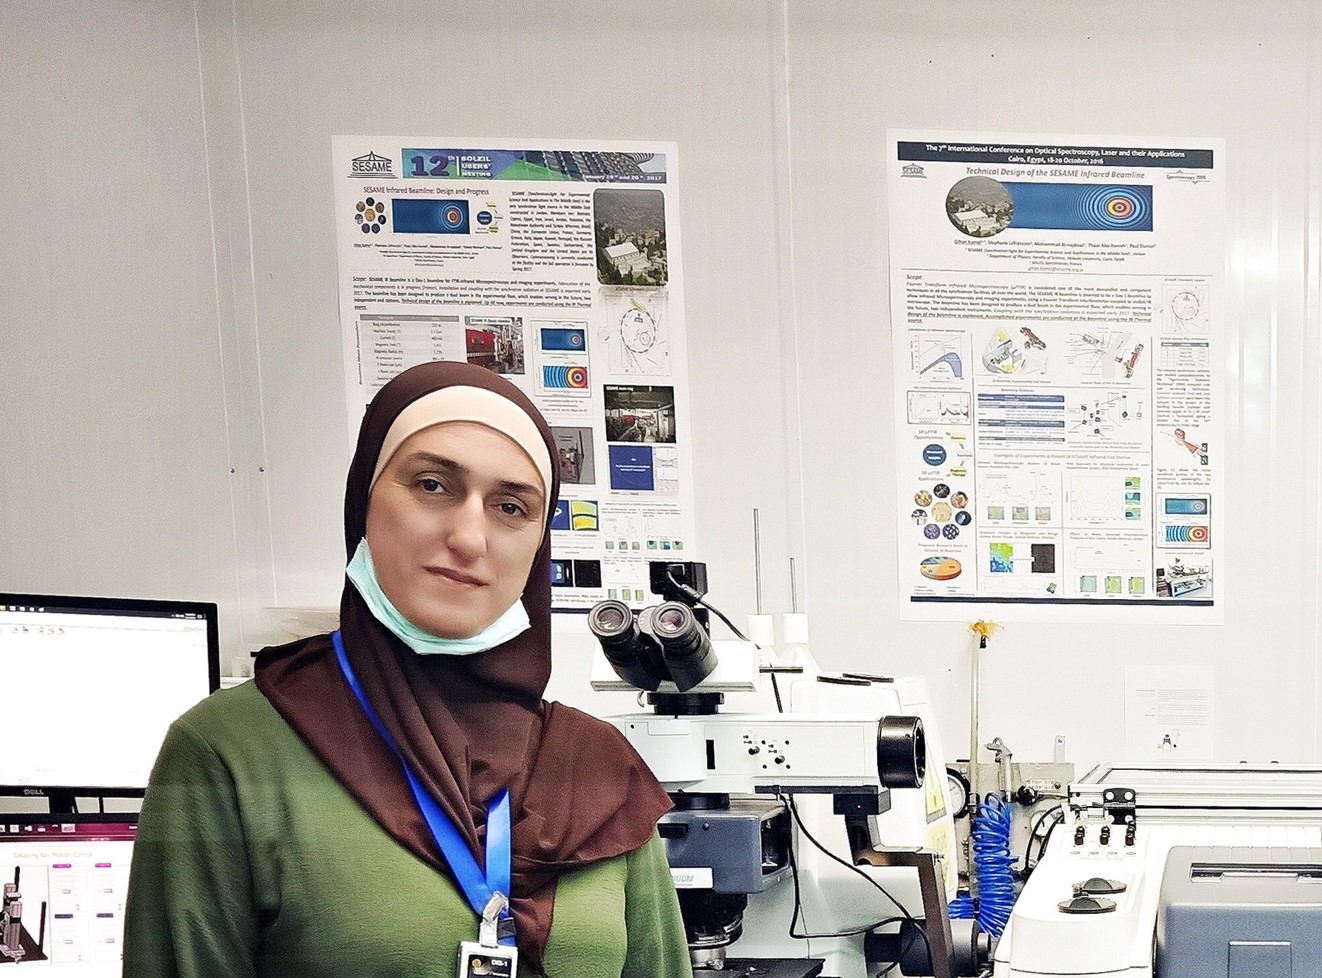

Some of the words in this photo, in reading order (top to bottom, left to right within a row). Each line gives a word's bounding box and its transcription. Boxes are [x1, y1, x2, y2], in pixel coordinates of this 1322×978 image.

[948, 145, 988, 153] International
[989, 146, 1024, 154] Conference
[1058, 148, 1100, 157] Spectroscopy,
[1147, 150, 1185, 158] Applications
[1008, 155, 1026, 163] Cairo,
[352, 161, 392, 172] SESAME
[966, 167, 999, 175] Technical
[1001, 168, 1025, 177] Design
[1026, 168, 1035, 177] of
[1050, 169, 1078, 177] SESAME
[1080, 170, 1109, 178] Infrared
[437, 188, 454, 196] Design
[467, 189, 489, 197] Progress
